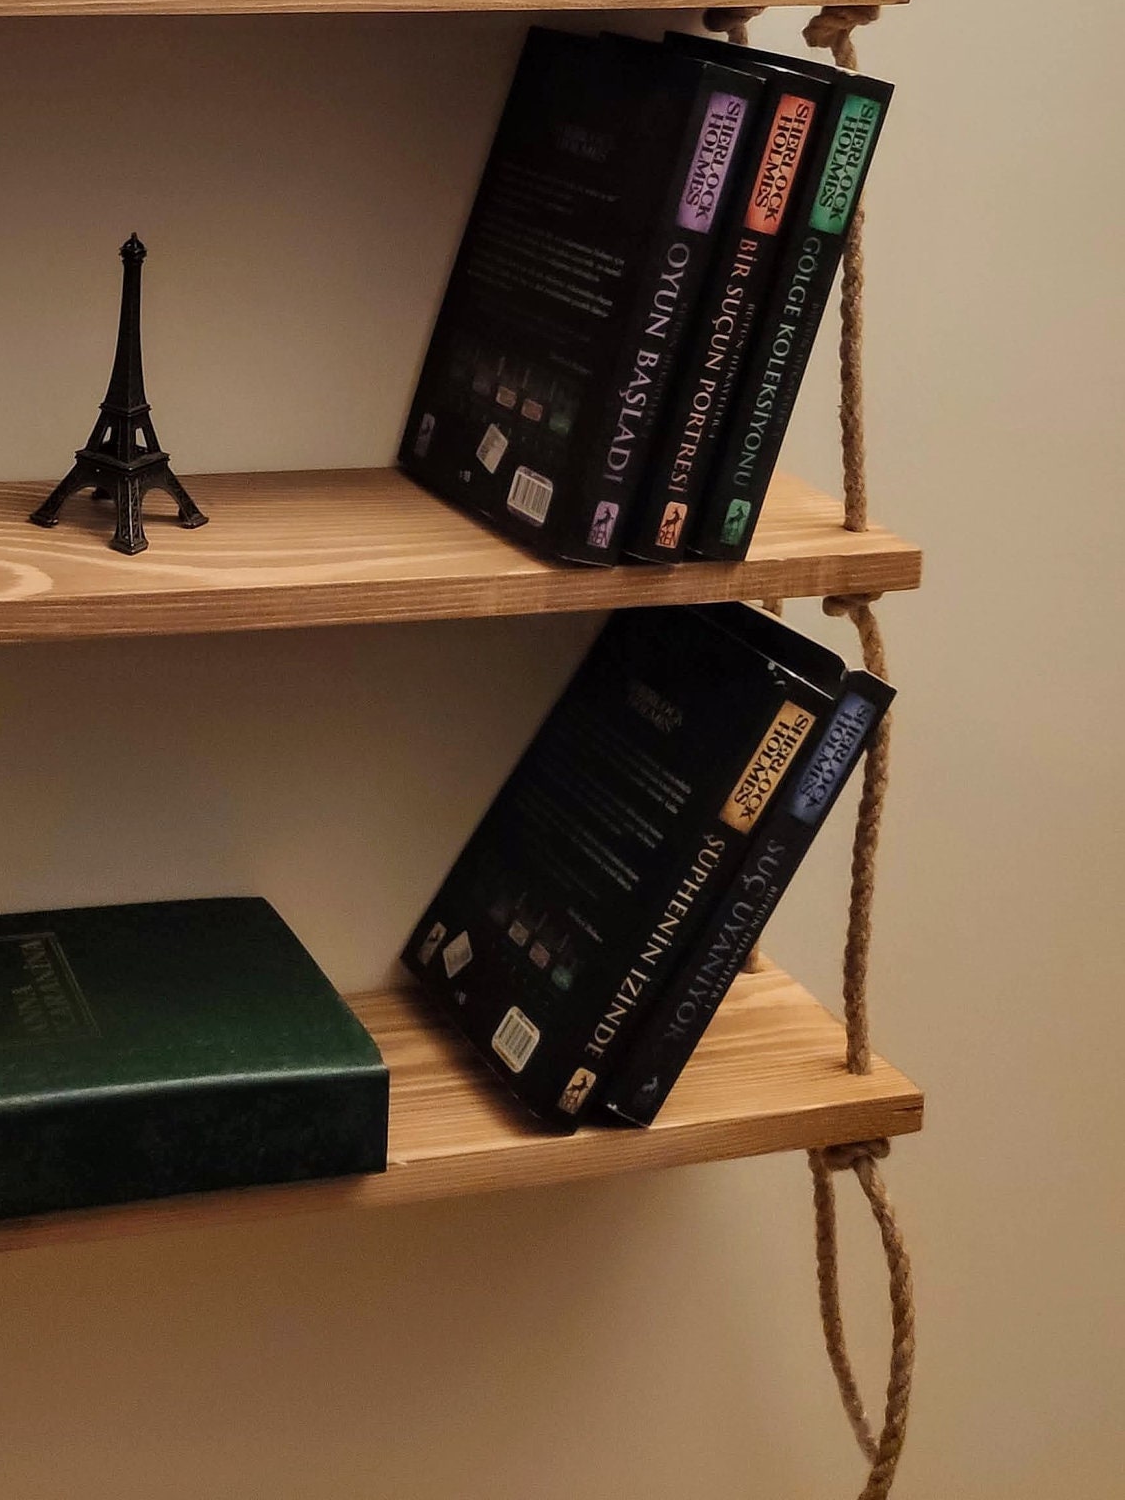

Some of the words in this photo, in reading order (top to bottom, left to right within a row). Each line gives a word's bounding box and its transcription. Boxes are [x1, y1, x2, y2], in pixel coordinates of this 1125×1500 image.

[686, 112, 724, 206] HOLMES
[696, 100, 741, 220] SHERLOCK
[755, 114, 792, 208] HOLMES
[764, 103, 810, 221] SHERLOCK
[819, 115, 857, 208] HOLMES
[829, 104, 874, 221] SHERLOCK
[645, 242, 690, 339] OYUN
[730, 237, 758, 277] BİR
[783, 236, 822, 317] GÖLGE
[705, 284, 744, 370] SUÇUN
[603, 349, 660, 484] BAŞLADI
[733, 323, 796, 486] KOLEKSİYONU
[734, 721, 791, 806] HOLMES
[739, 714, 809, 821] SHERLOCK
[804, 704, 868, 808] SHERLOCK
[639, 833, 725, 965] ŞÜPHENİN
[741, 838, 785, 892] SUÇ
[584, 967, 651, 1060] İZİNDE
[664, 900, 755, 1039] UYANIYOR
